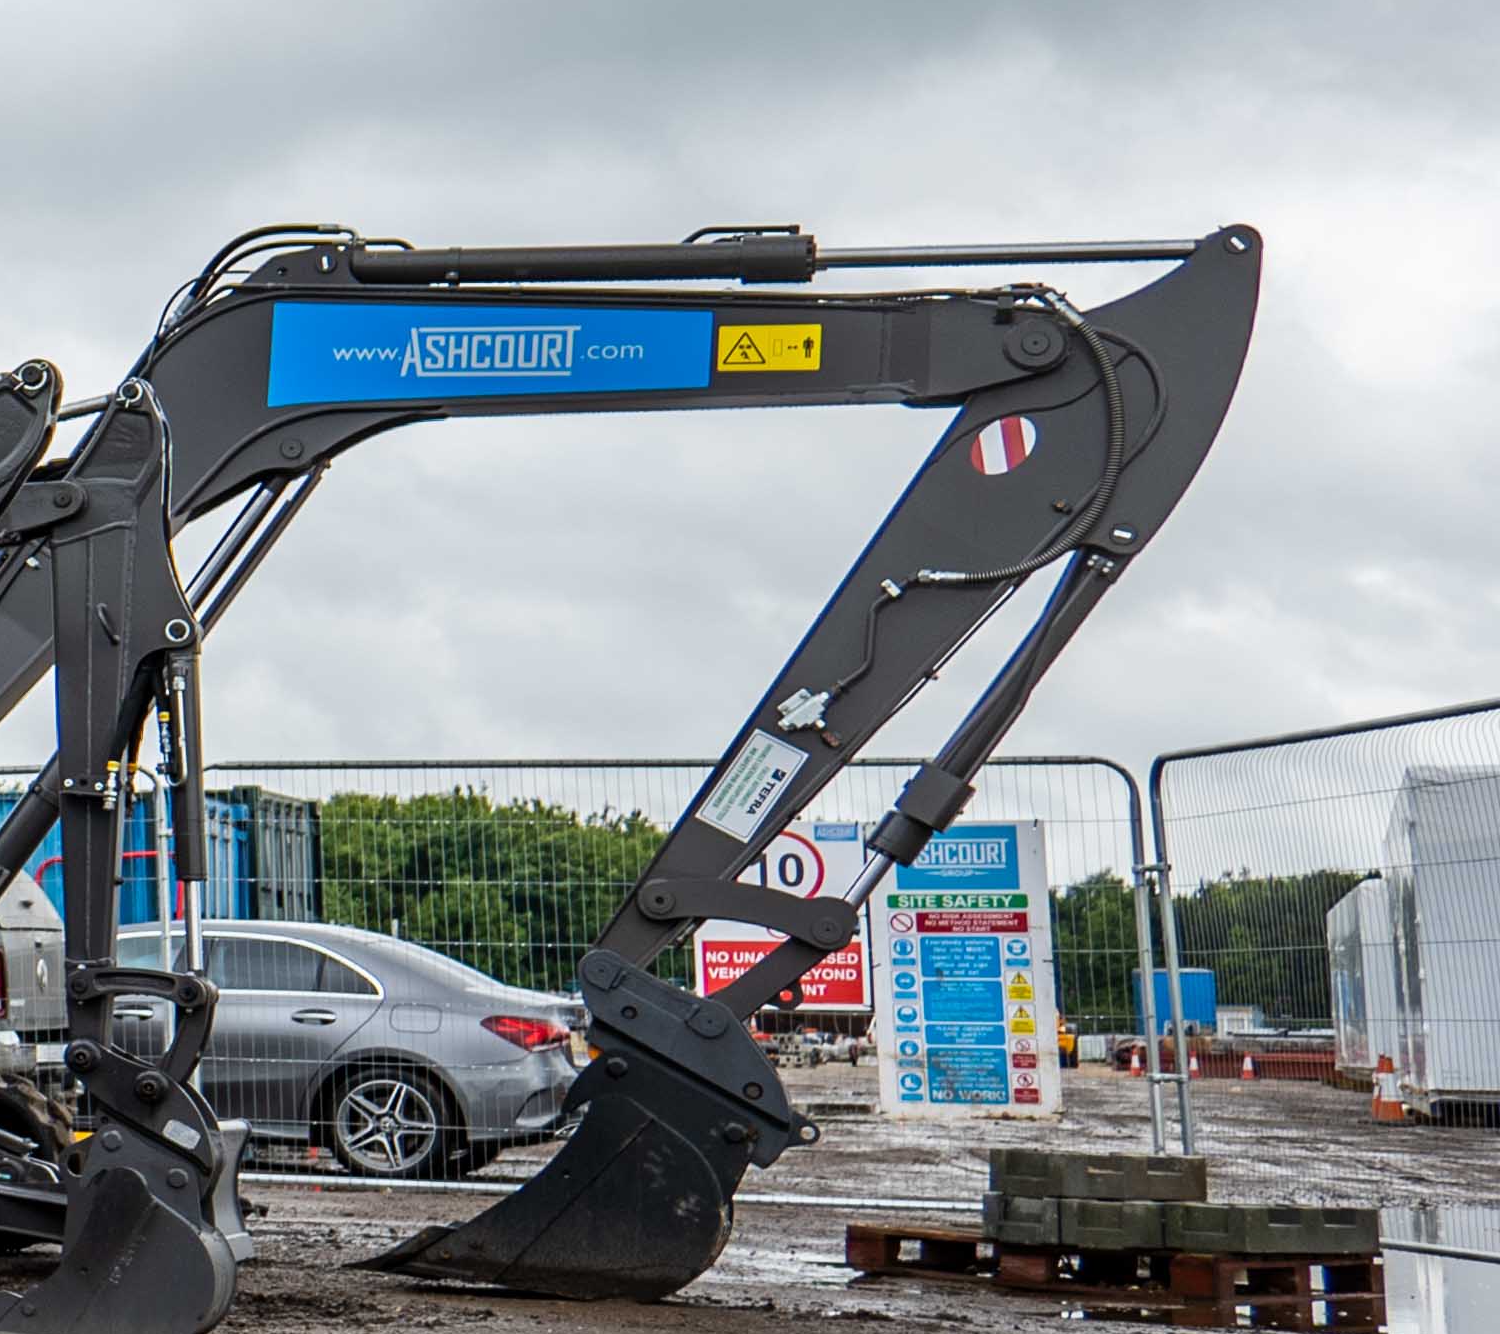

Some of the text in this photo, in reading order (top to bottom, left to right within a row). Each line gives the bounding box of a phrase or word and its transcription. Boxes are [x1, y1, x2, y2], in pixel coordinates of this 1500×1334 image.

[332, 325, 645, 378] www.ASHCOURT.com
[746, 781, 776, 815] TEFRA
[914, 838, 1009, 869] SHCOURT
[759, 853, 805, 888] 10
[897, 895, 1013, 908] SITE SAFETY
[706, 951, 729, 964] NO
[801, 968, 857, 981] EYOND
[932, 1089, 954, 1101] NO
